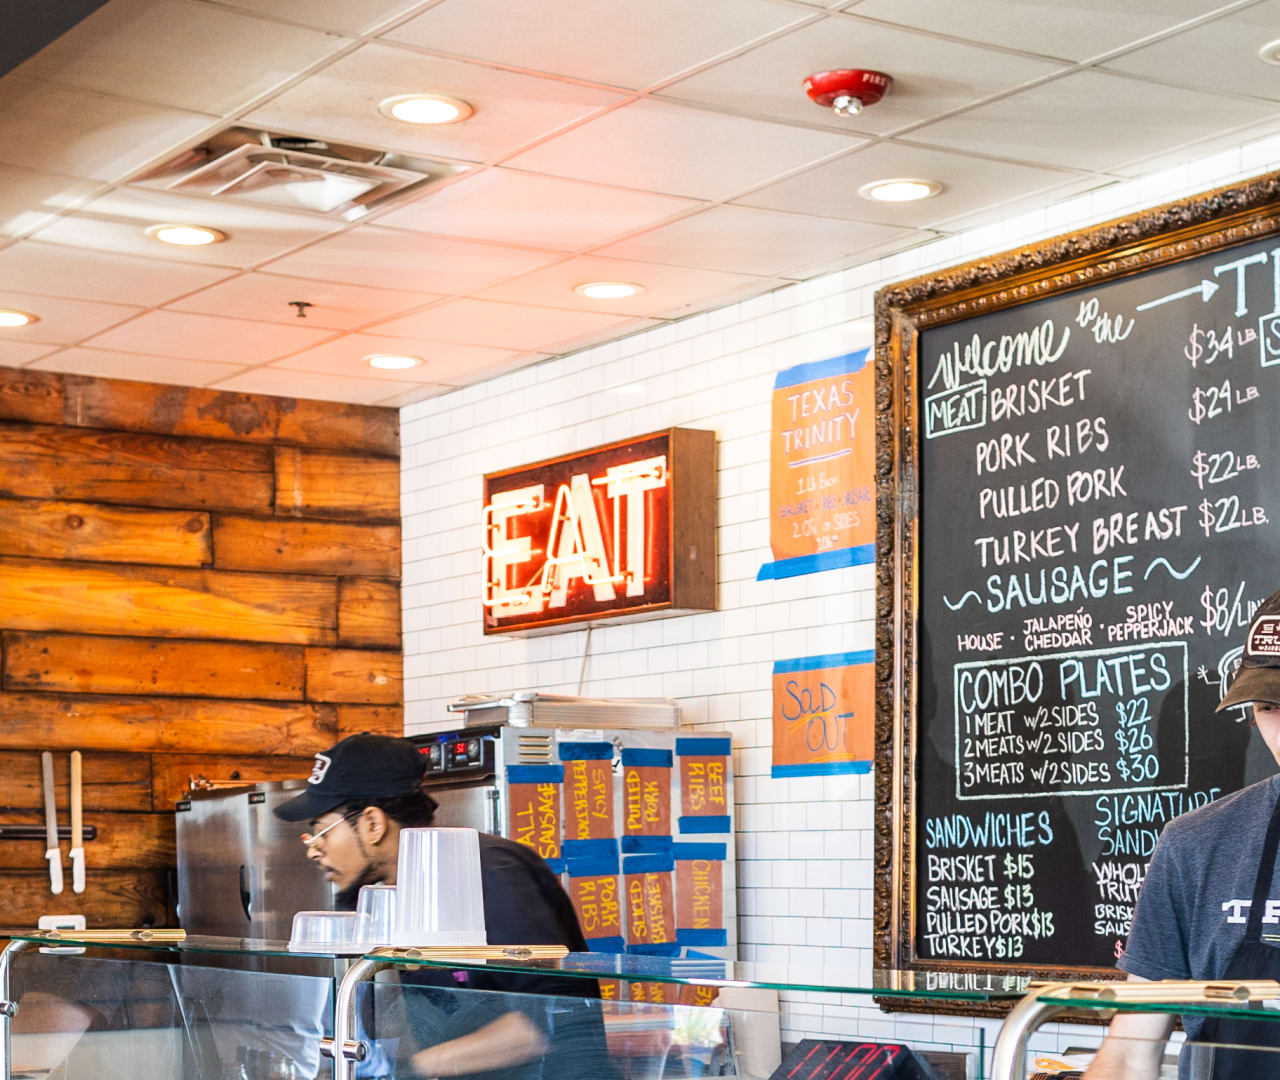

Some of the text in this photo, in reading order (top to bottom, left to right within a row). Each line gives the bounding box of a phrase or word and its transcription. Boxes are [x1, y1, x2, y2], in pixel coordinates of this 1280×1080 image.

[928, 319, 1070, 390] Welcome
[1076, 298, 1099, 325] to
[1091, 310, 1135, 343] the
[787, 379, 854, 422] TEXAS
[930, 390, 979, 431] MEAT
[990, 369, 1092, 421] BRISKET
[781, 407, 860, 455] TRINITY
[976, 432, 1036, 475] PORK
[1047, 417, 1109, 460] RIBS
[979, 477, 1060, 519] PULLED
[1068, 465, 1128, 506] PORK
[482, 455, 667, 619] EAT
[974, 522, 1080, 568] TURKEY
[1092, 505, 1188, 555] BREAST
[986, 555, 1135, 613] SAUSAGE
[1107, 616, 1195, 642] PEPPERJACK
[1126, 600, 1174, 624] SPICY
[957, 632, 1005, 652] HOUSE
[1024, 630, 1093, 652] CHEDDAR
[960, 653, 1171, 713] COMBO PLATES
[806, 711, 854, 753] OUT
[1115, 698, 1152, 727] $22
[1114, 727, 1154, 754] $26
[687, 762, 706, 810] RIBS
[707, 761, 725, 806] BEEF
[1116, 754, 1160, 782] $30
[591, 768, 609, 819] SPICY
[627, 770, 643, 830] PULLED
[644, 780, 661, 822] PORK
[516, 801, 536, 848] ALL
[537, 782, 558, 860] SAUSAGE
[925, 810, 1054, 849] SANDWICHES
[928, 852, 1035, 882] BRISKET $15
[579, 880, 600, 932] RIBS
[598, 876, 620, 928] PORK
[647, 871, 667, 945] BRISKET
[691, 859, 712, 929] CHICKEN
[926, 884, 1035, 911] SAUSAGE $13
[926, 910, 987, 937] PULLED
